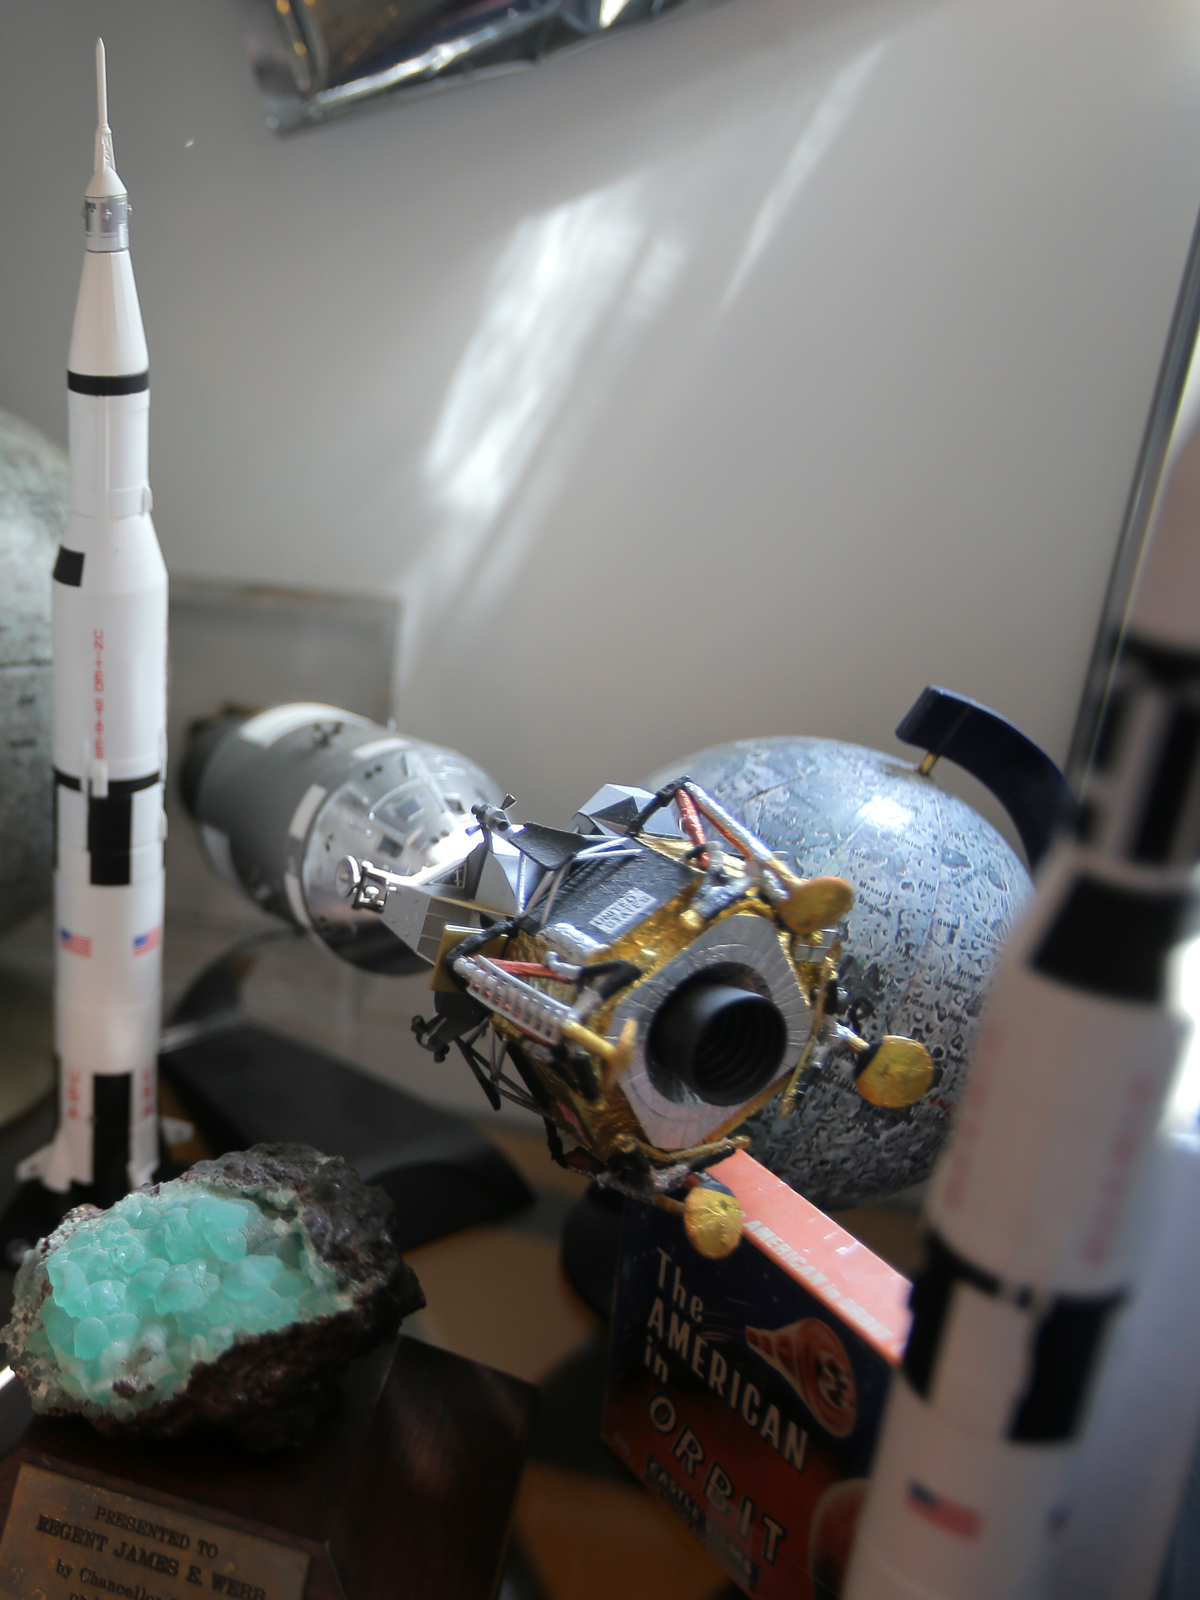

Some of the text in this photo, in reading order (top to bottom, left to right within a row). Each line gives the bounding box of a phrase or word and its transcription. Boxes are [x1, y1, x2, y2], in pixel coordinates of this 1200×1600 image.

[93, 628, 104, 692] UNITED
[594, 894, 637, 926] UNITED
[605, 895, 650, 929] STATES
[657, 1247, 704, 1323] The
[644, 1334, 669, 1385] in
[647, 1297, 808, 1476] AMERICAN
[649, 1392, 787, 1566] ORBIT
[36, 1514, 110, 1552] REGENT
[114, 1541, 180, 1577] JAMES
[94, 1505, 219, 1560] PRESENTED TO
[55, 1558, 73, 1580] by
